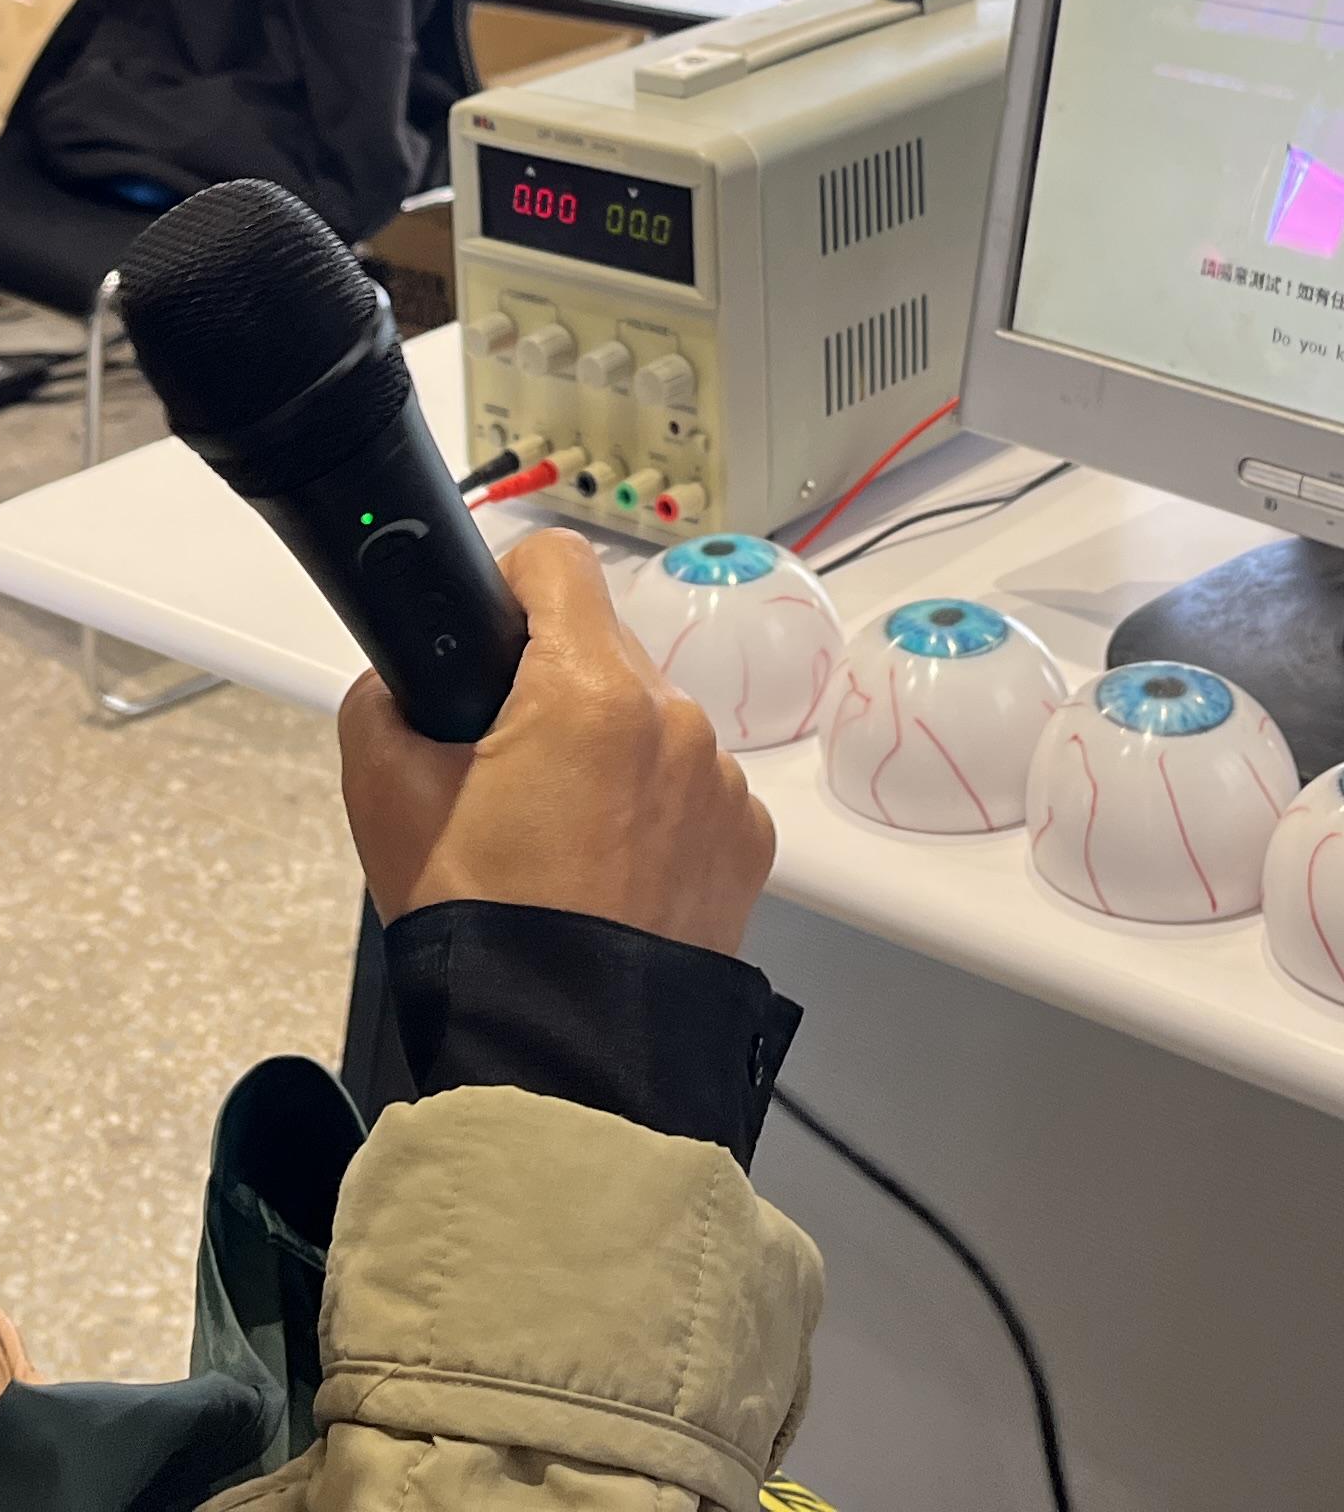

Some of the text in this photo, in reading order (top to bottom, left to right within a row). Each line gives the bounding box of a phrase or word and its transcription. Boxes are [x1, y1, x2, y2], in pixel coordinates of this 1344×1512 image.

[513, 183, 577, 225] 0.00
[1272, 327, 1291, 347] Do
[1299, 338, 1327, 357] you
